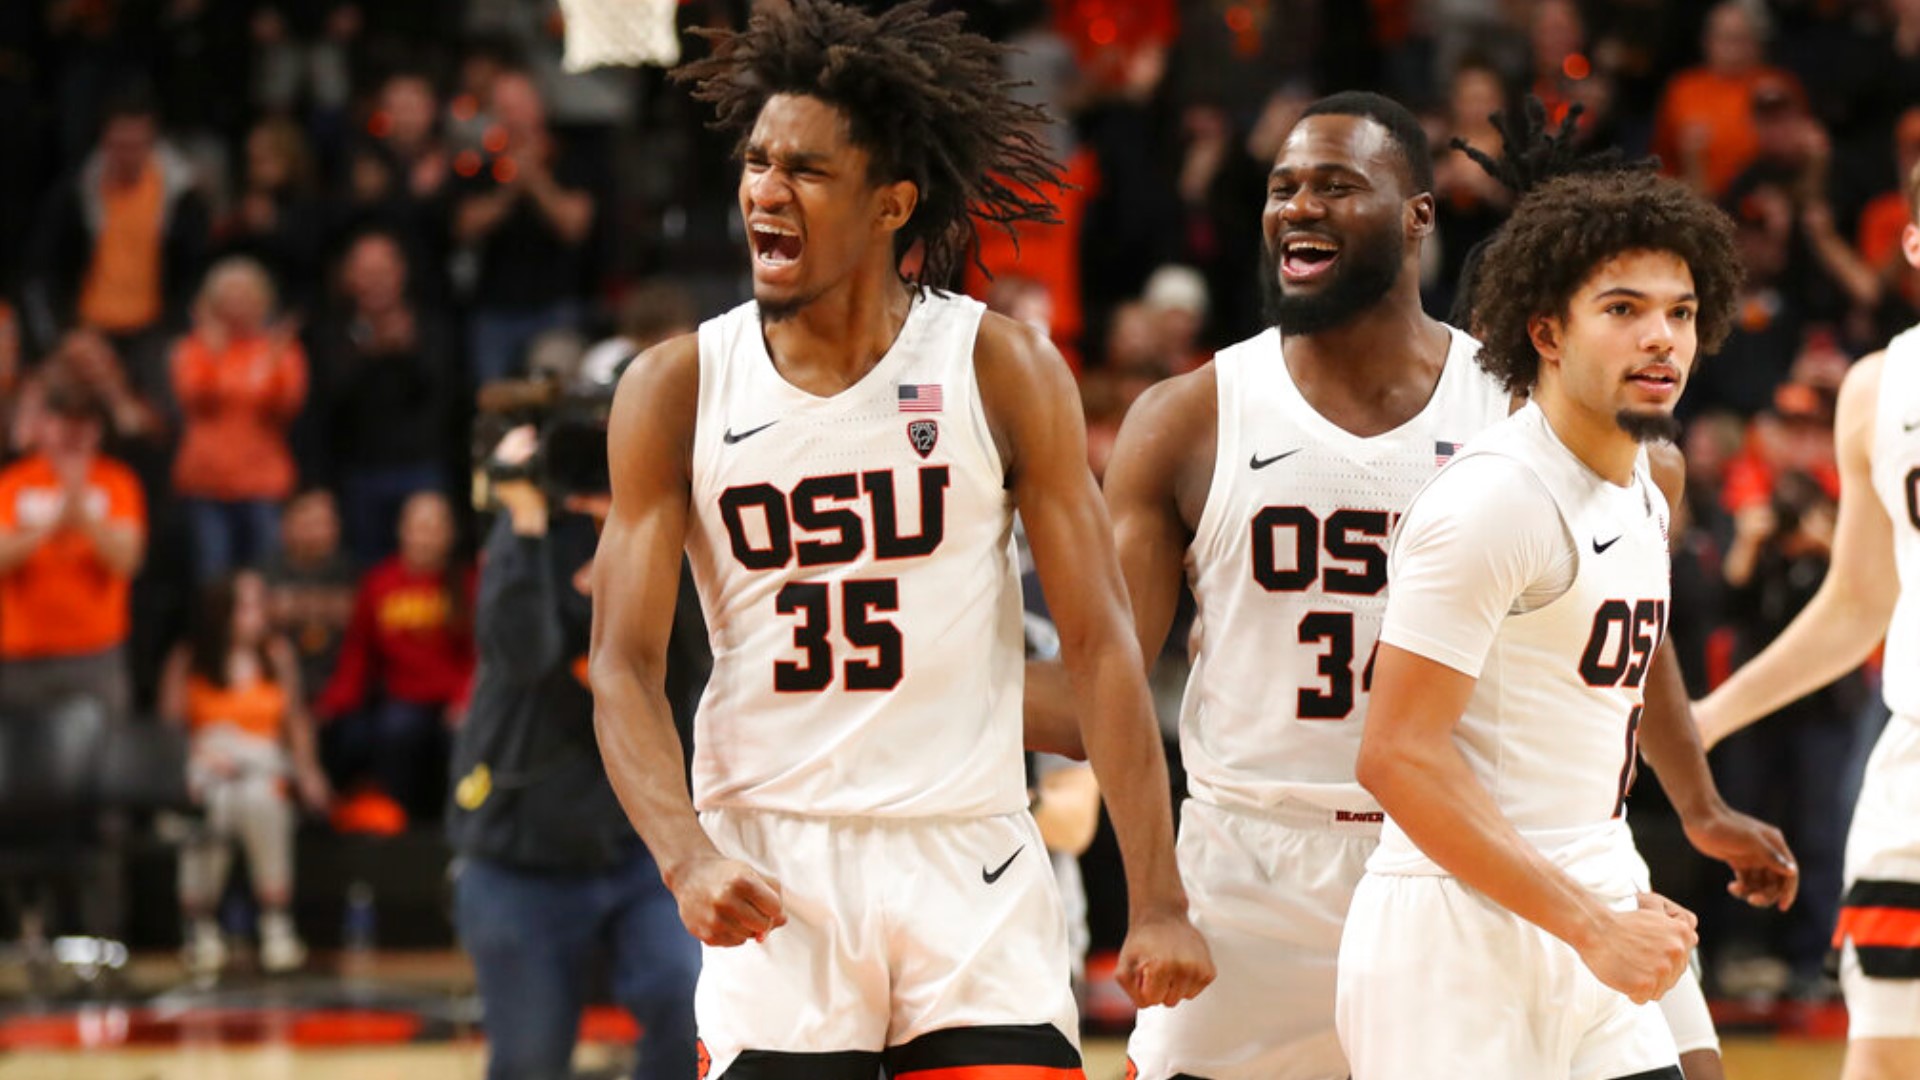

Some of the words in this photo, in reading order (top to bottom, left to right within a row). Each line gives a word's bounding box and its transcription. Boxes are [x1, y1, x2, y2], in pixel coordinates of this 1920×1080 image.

[917, 435, 931, 450] 12
[718, 465, 950, 570] OSU
[1251, 506, 1402, 596] OS
[774, 578, 903, 692] 35
[1296, 611, 1380, 720] 3
[1578, 599, 1664, 688] OS
